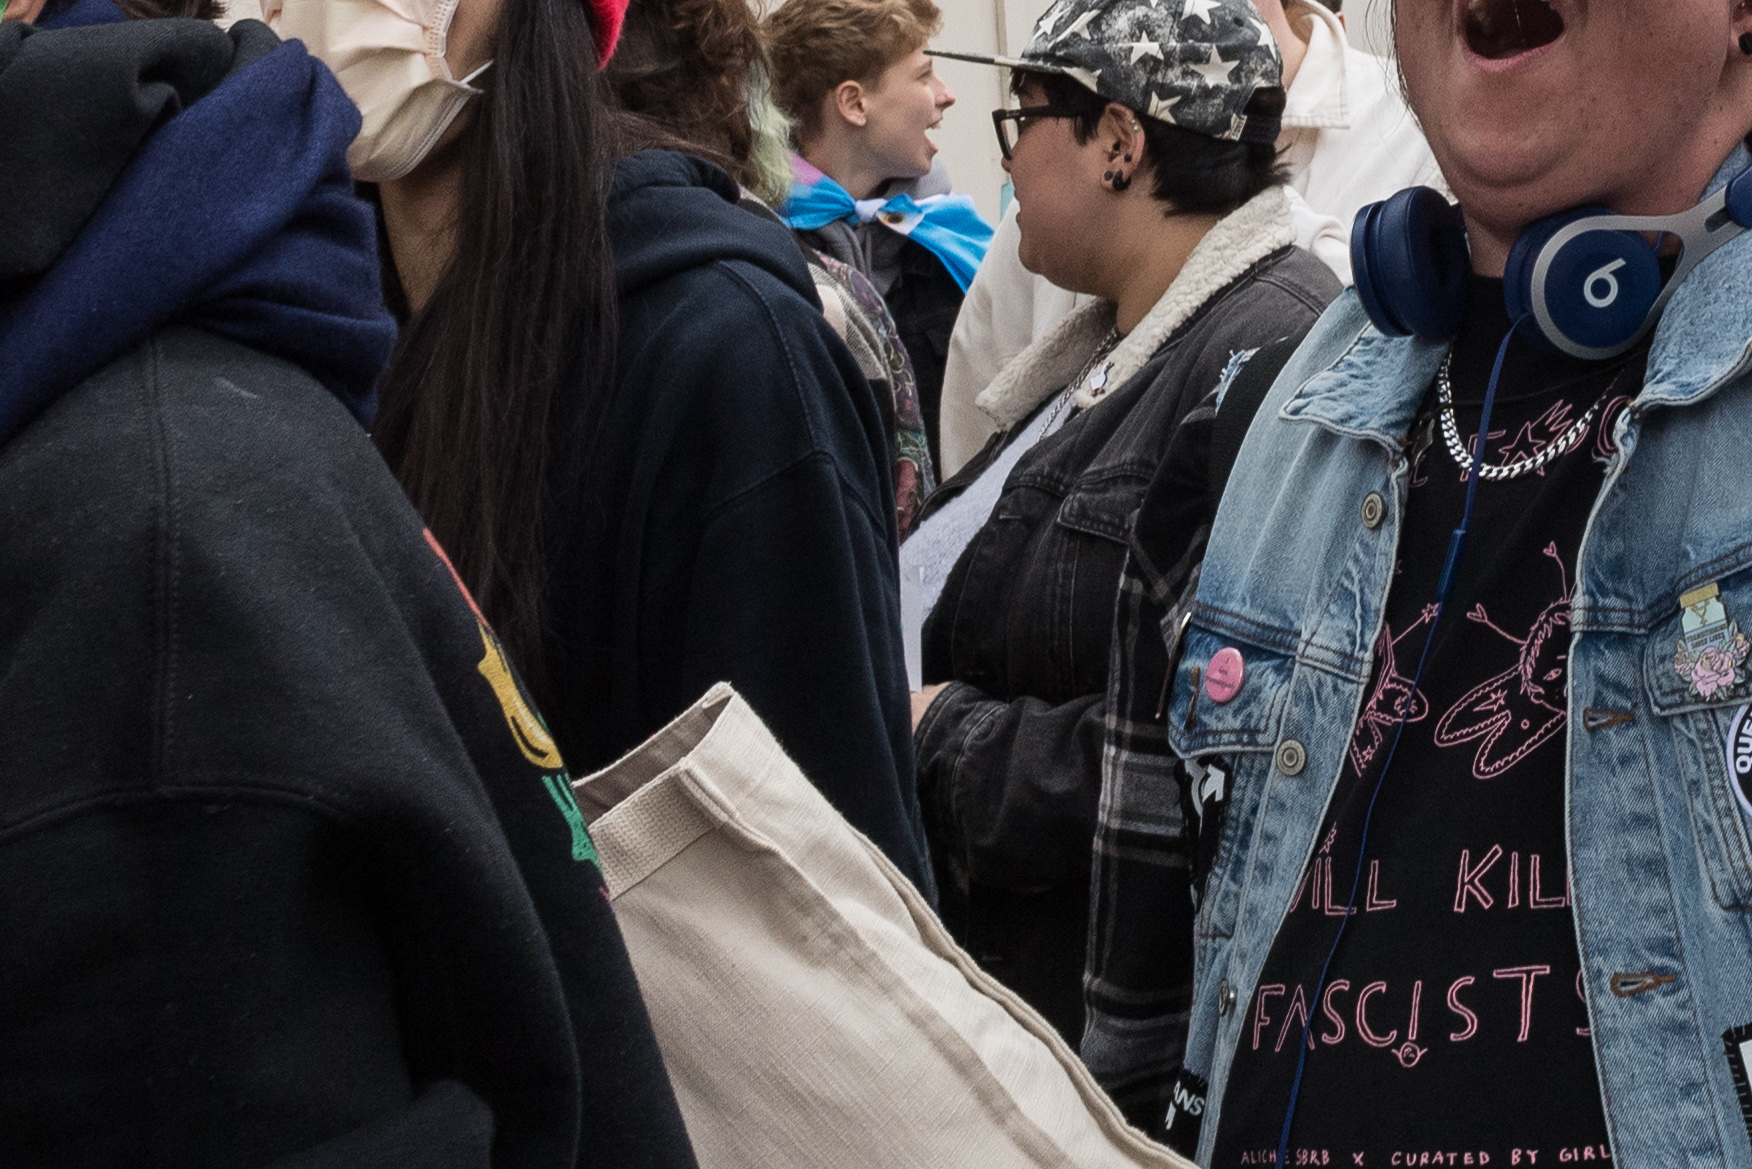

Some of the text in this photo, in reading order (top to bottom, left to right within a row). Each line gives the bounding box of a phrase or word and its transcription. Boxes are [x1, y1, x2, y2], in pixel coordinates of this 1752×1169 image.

[1289, 843, 1574, 915] ILL KIL
[1252, 964, 1591, 1053] FASCIST
[1391, 1149, 1491, 1167] CURATED
[1511, 1147, 1540, 1166] BY
